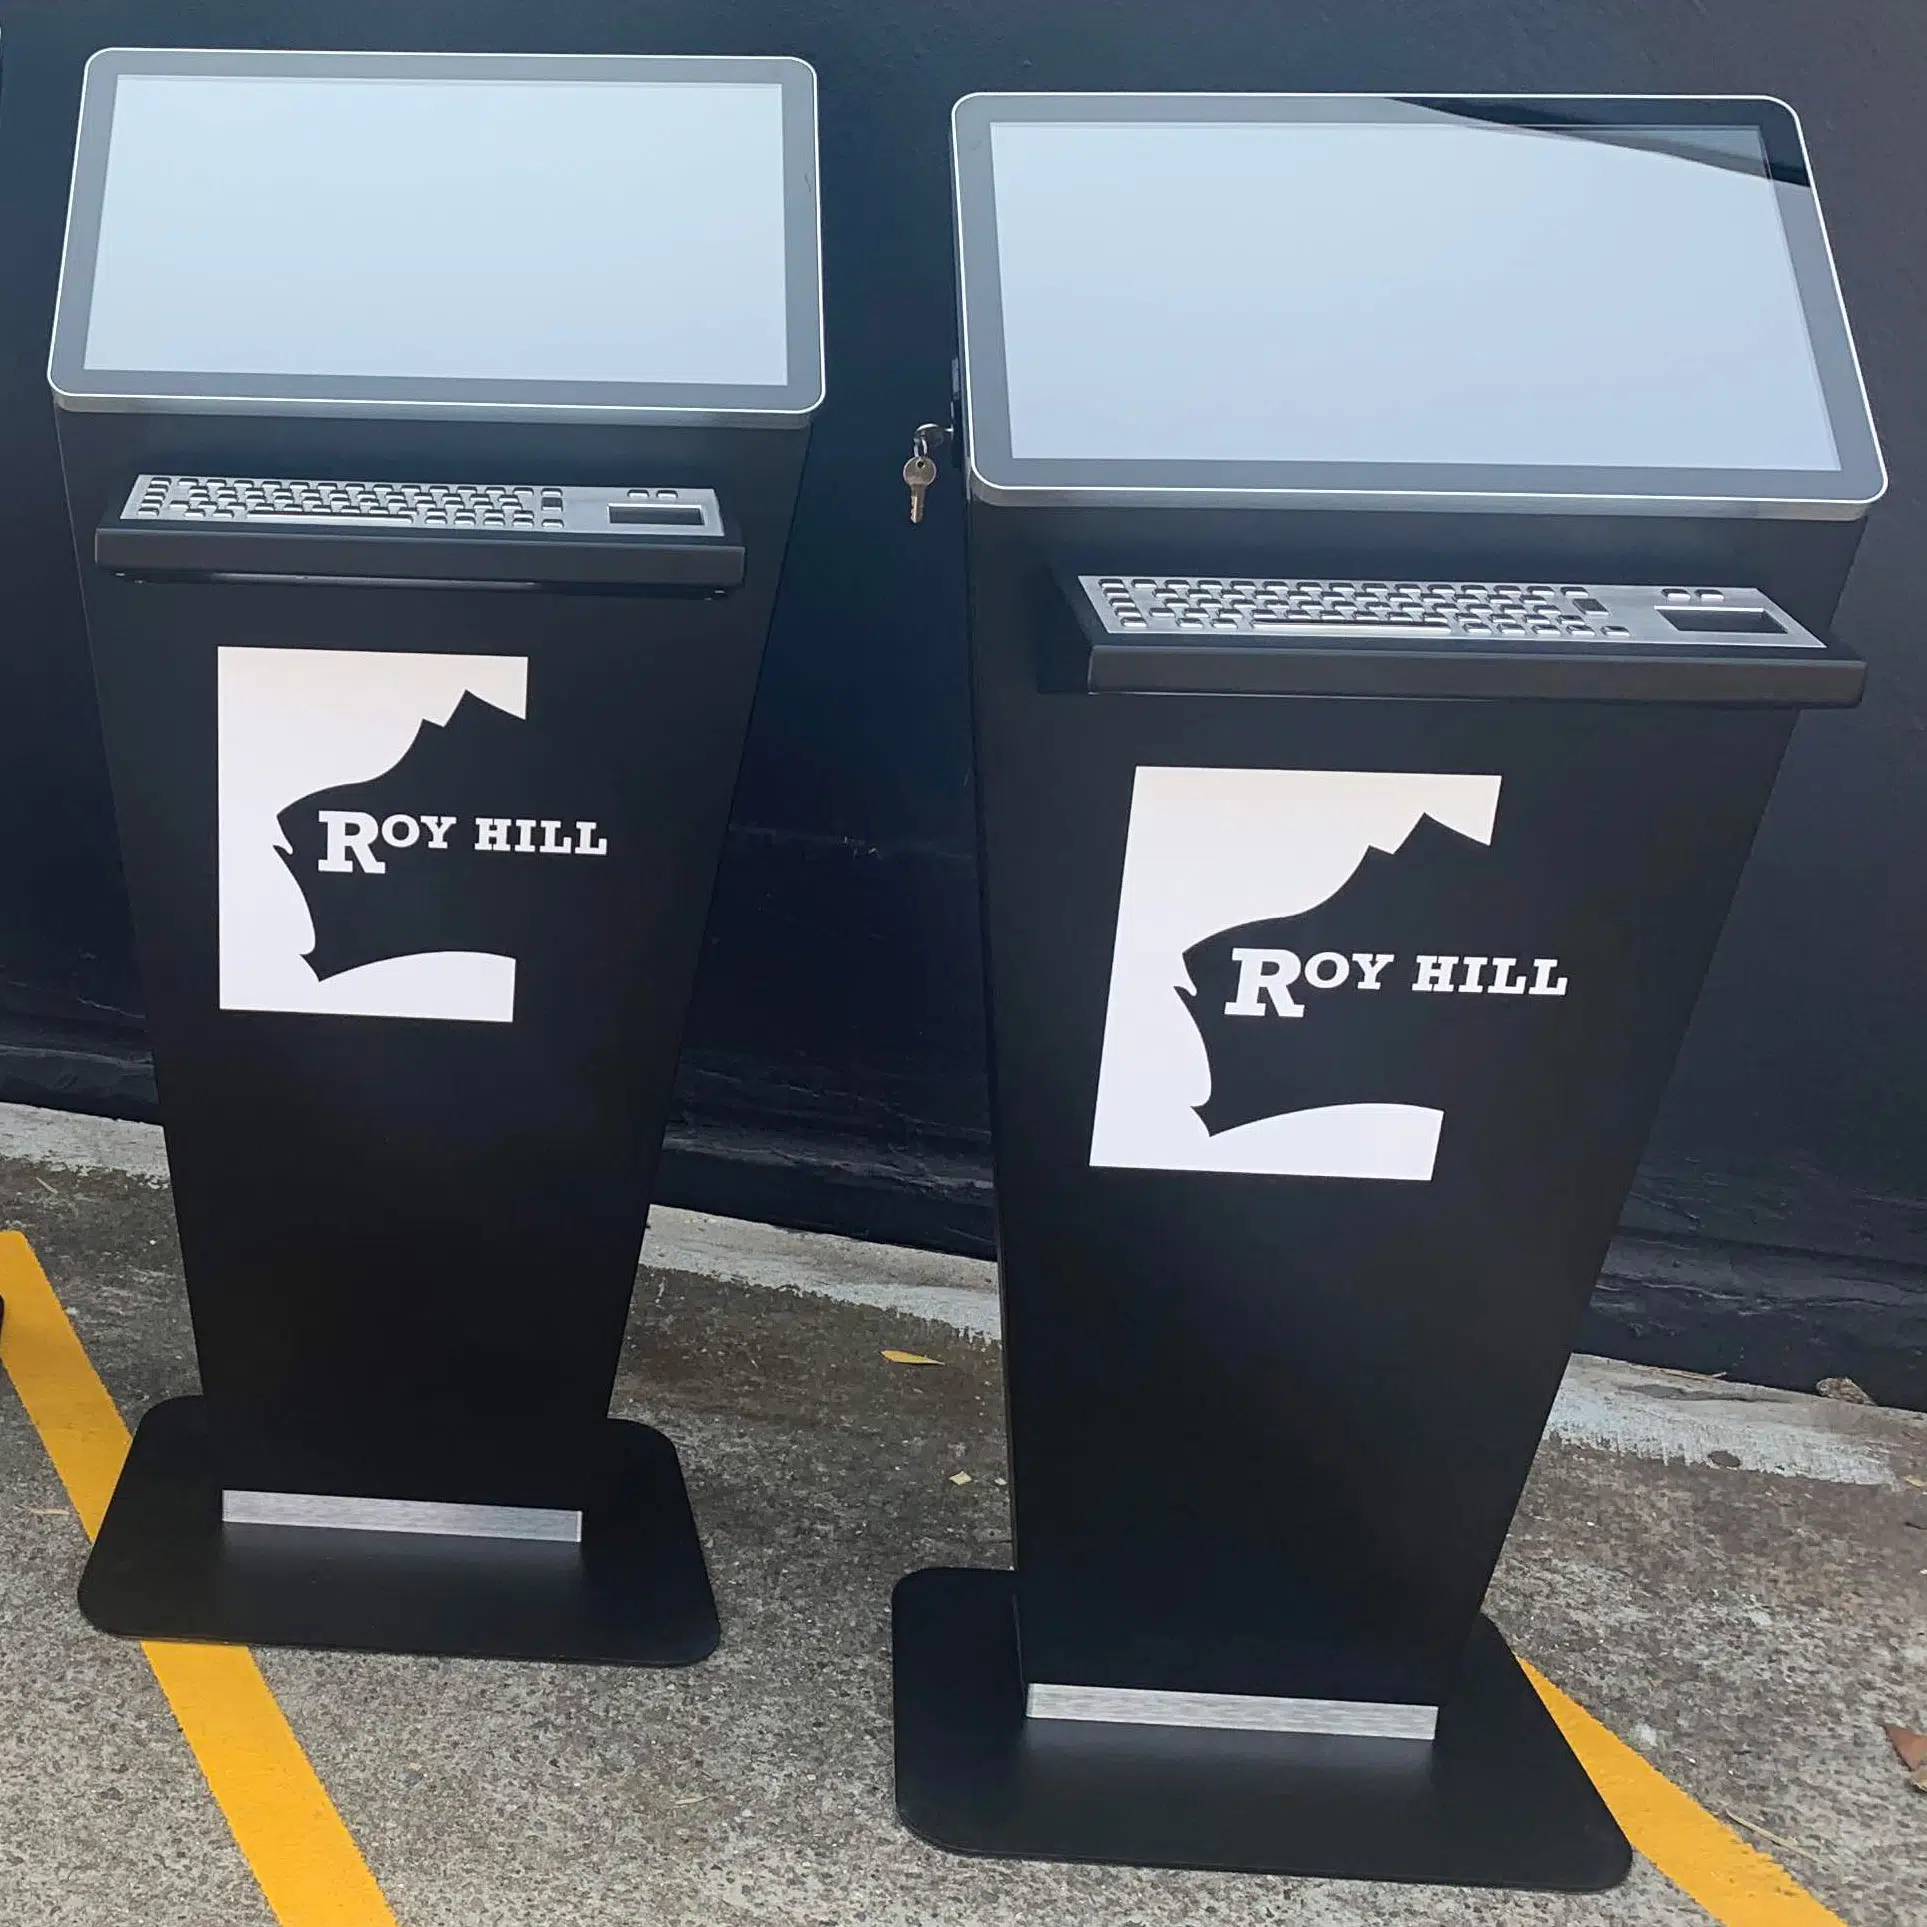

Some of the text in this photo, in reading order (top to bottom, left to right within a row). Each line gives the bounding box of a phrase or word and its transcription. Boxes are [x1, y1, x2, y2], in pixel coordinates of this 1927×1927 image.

[318, 811, 607, 874] ROY HILL
[1224, 948, 1568, 1018] ROY HILL
